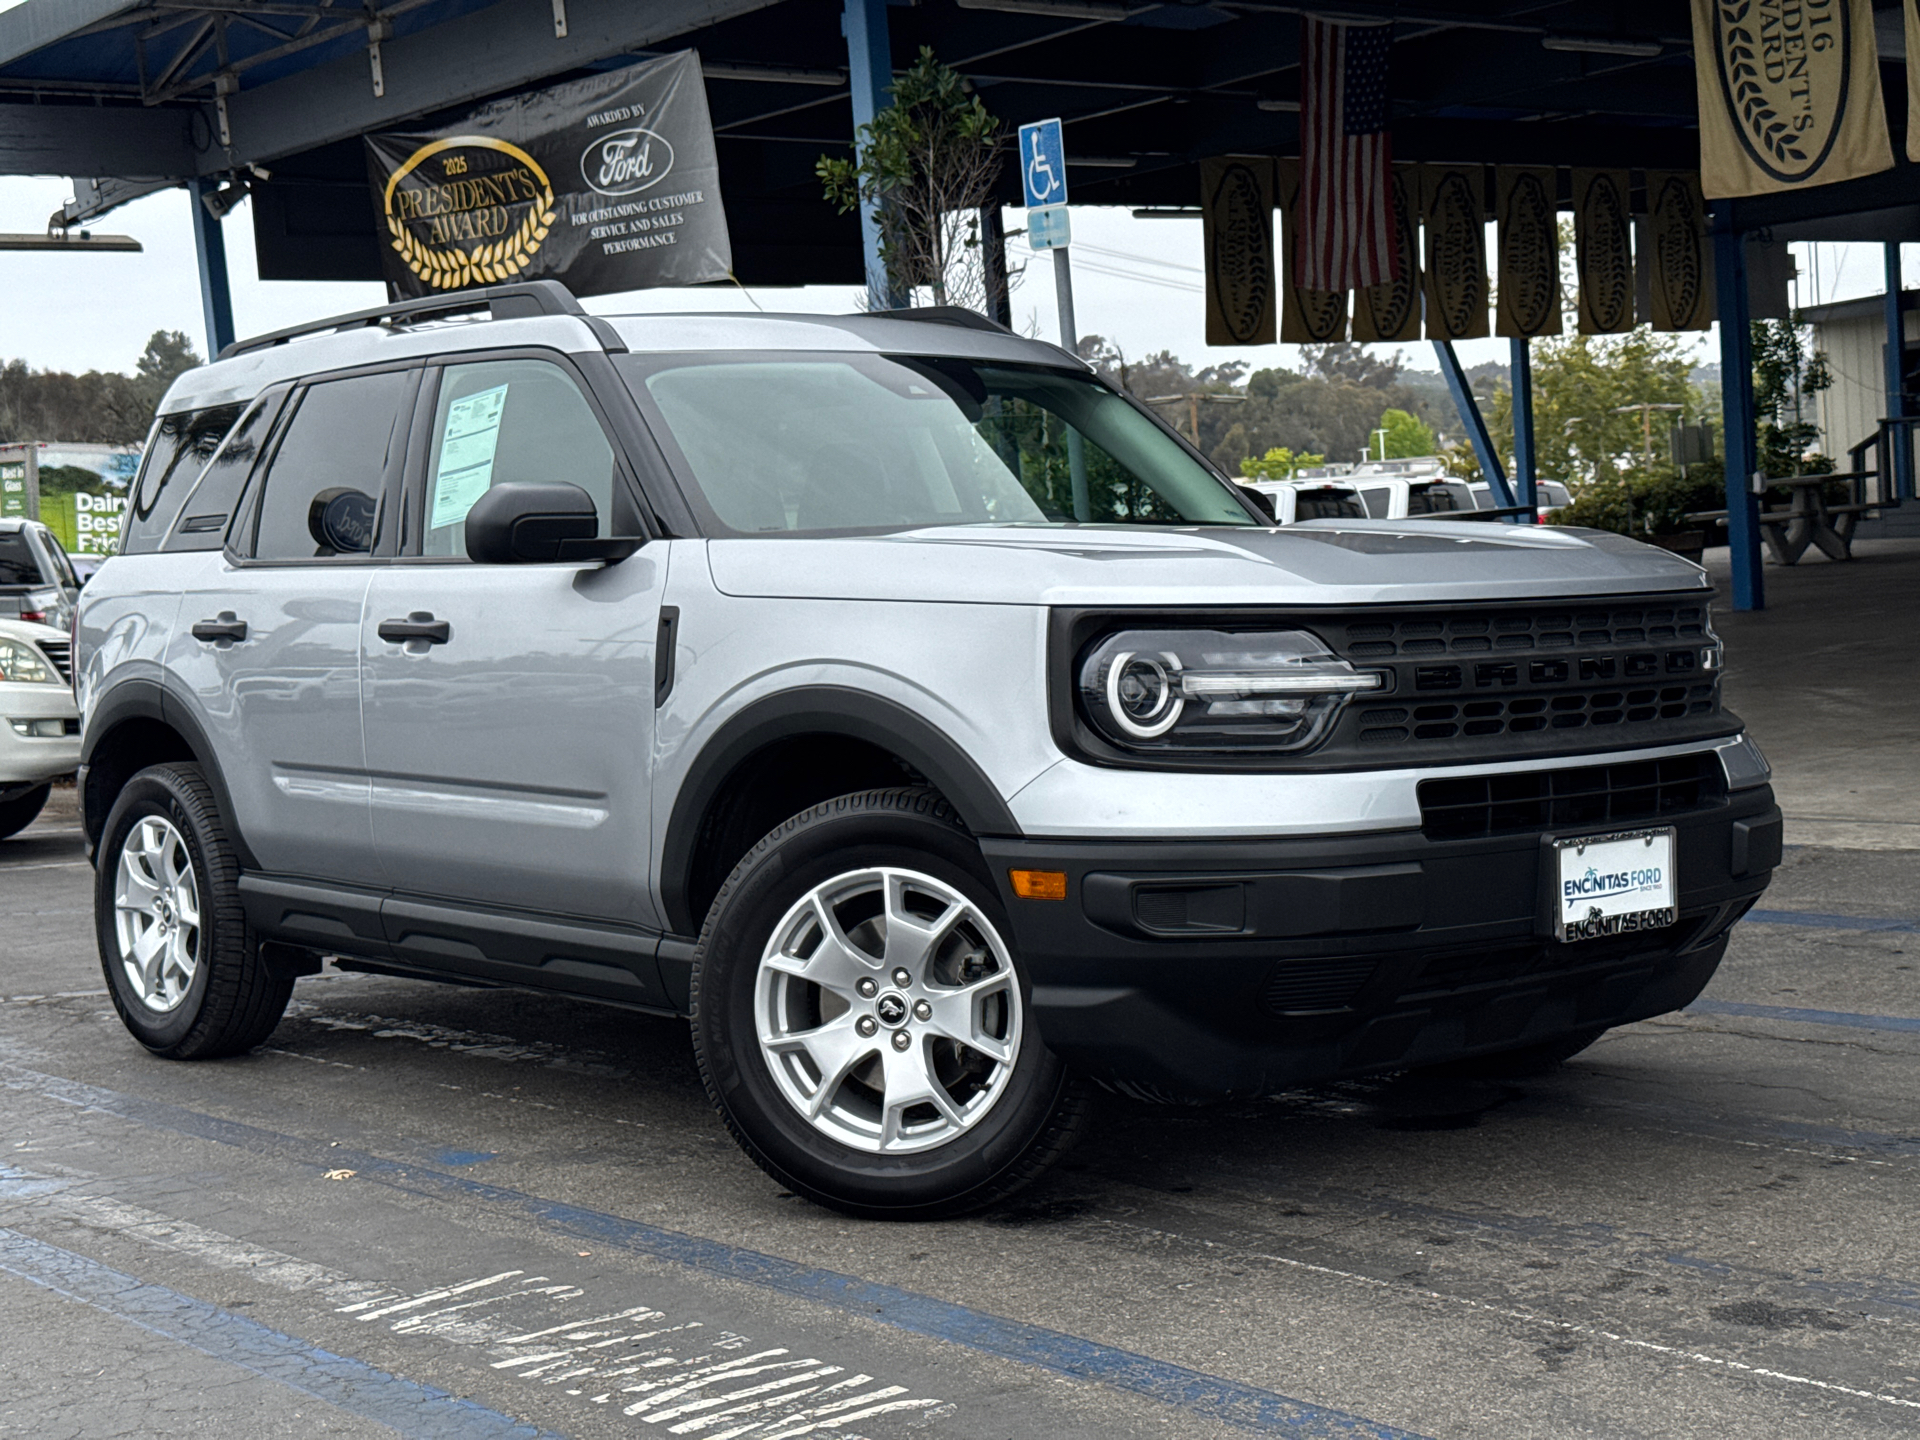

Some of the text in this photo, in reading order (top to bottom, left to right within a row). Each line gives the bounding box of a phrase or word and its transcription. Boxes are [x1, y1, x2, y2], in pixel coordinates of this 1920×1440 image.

[586, 103, 646, 128] AWARDED BY
[443, 156, 468, 176] 2025
[600, 138, 653, 186] Ford
[396, 168, 536, 220] PRESIDENT'S
[571, 190, 704, 226] FOR OUTSTANDING CUSTOMER
[430, 205, 508, 245] AWARD
[590, 212, 684, 240] SERVICE AND SALES
[602, 231, 677, 255] PERFORMANCE
[1415, 652, 1694, 691] BRONCO
[1564, 868, 1661, 896] ENCINITAS FORD
[1565, 908, 1673, 941] ENCINITAS FORD
